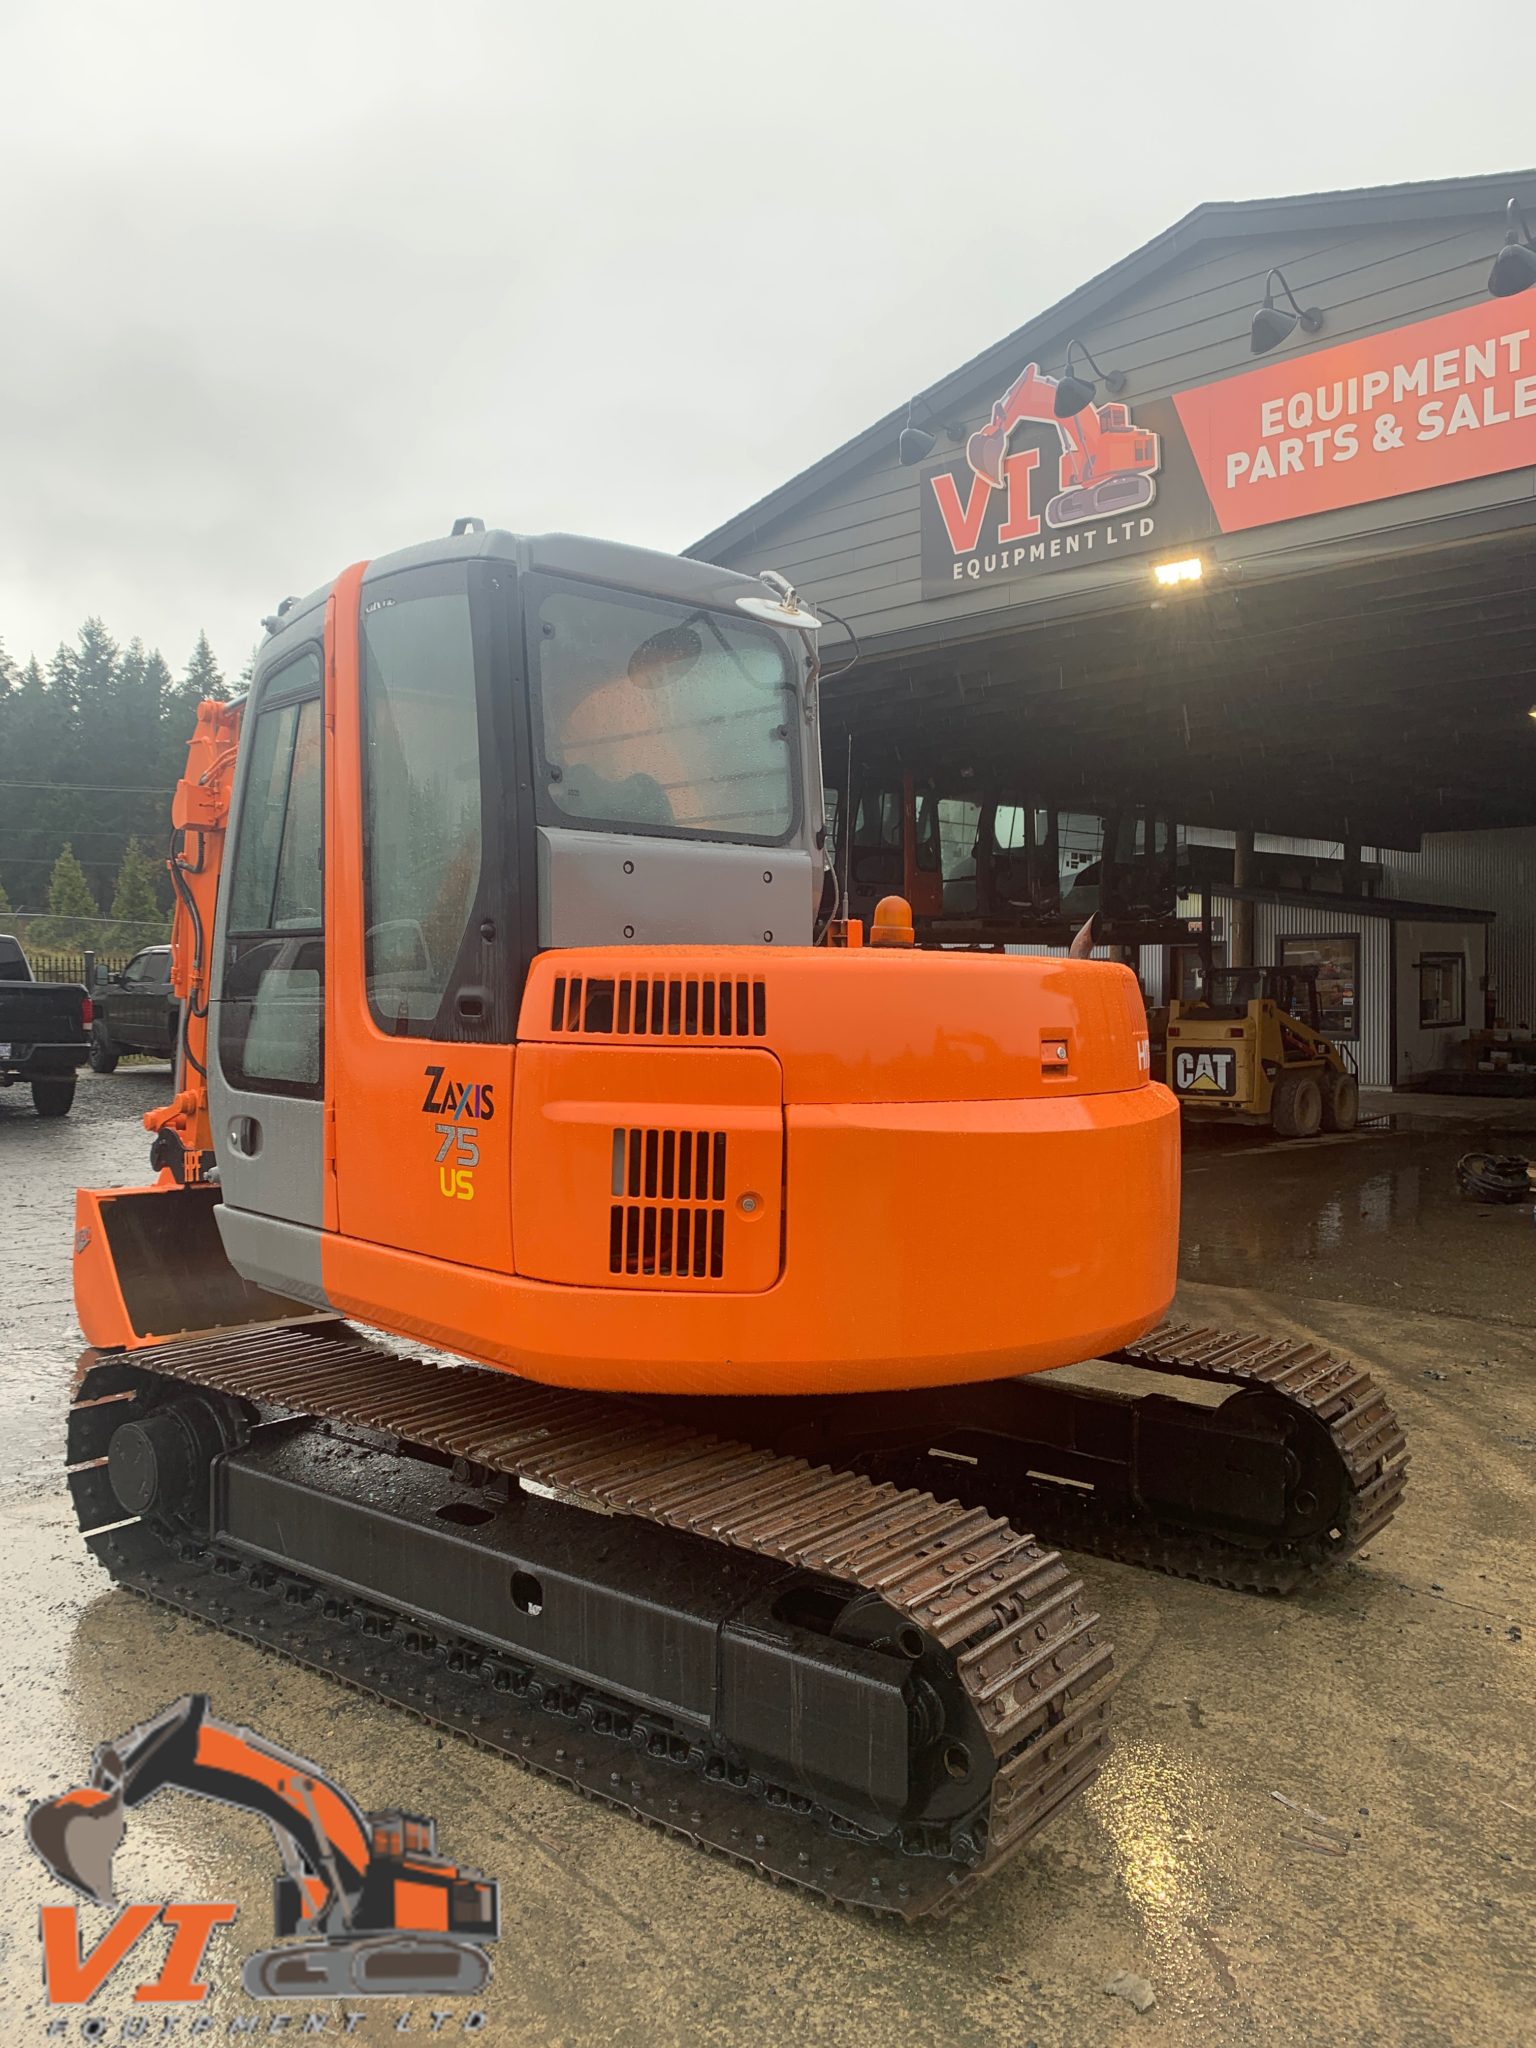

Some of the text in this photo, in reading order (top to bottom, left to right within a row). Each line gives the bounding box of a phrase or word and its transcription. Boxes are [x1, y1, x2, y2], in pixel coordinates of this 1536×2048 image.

[1260, 328, 1531, 439] EQUIPMENT
[1226, 374, 1536, 489] PARTS & SALE
[930, 447, 1041, 555] VI
[953, 517, 1155, 580] EQUIPMENT LTD
[1176, 1052, 1232, 1091] CAT
[434, 1123, 480, 1168] 75
[439, 1166, 475, 1201] US
